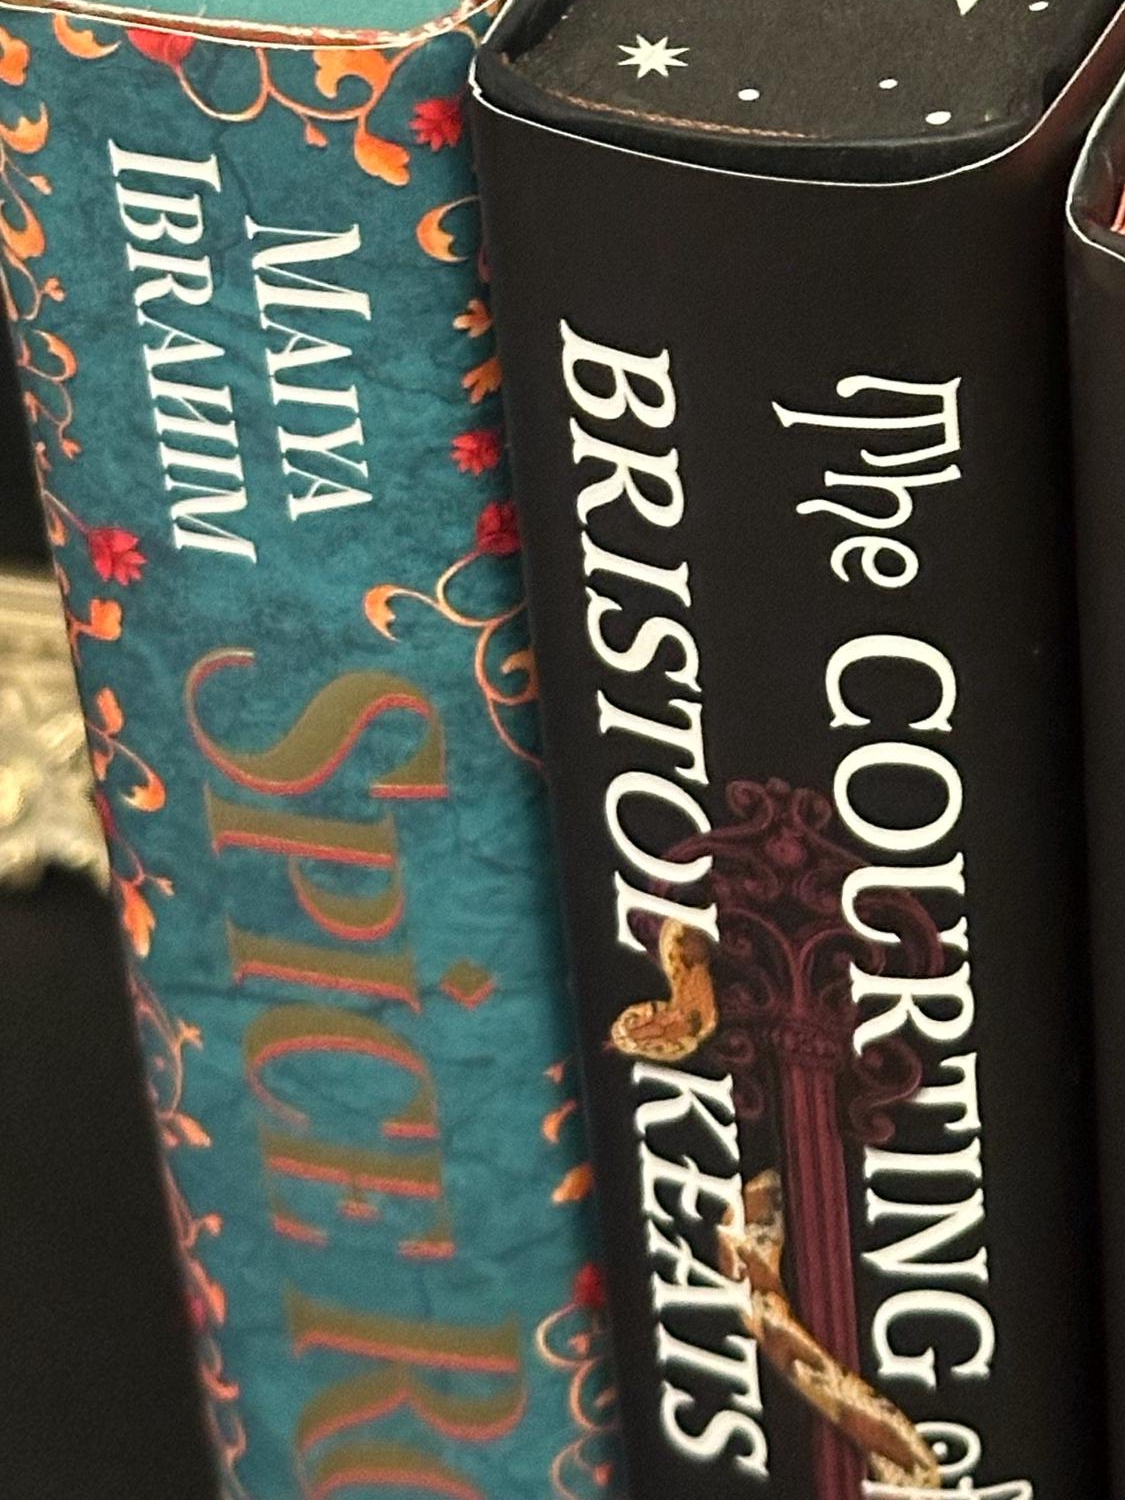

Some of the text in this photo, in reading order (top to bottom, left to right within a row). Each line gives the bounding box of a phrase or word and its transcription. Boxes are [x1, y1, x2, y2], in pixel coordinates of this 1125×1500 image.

[107, 139, 257, 563] IBRAHIM
[245, 215, 373, 520] MAIYA
[772, 374, 962, 588] The
[560, 318, 769, 1479] BRISTOL KEATS
[825, 634, 995, 1390] COURTING
